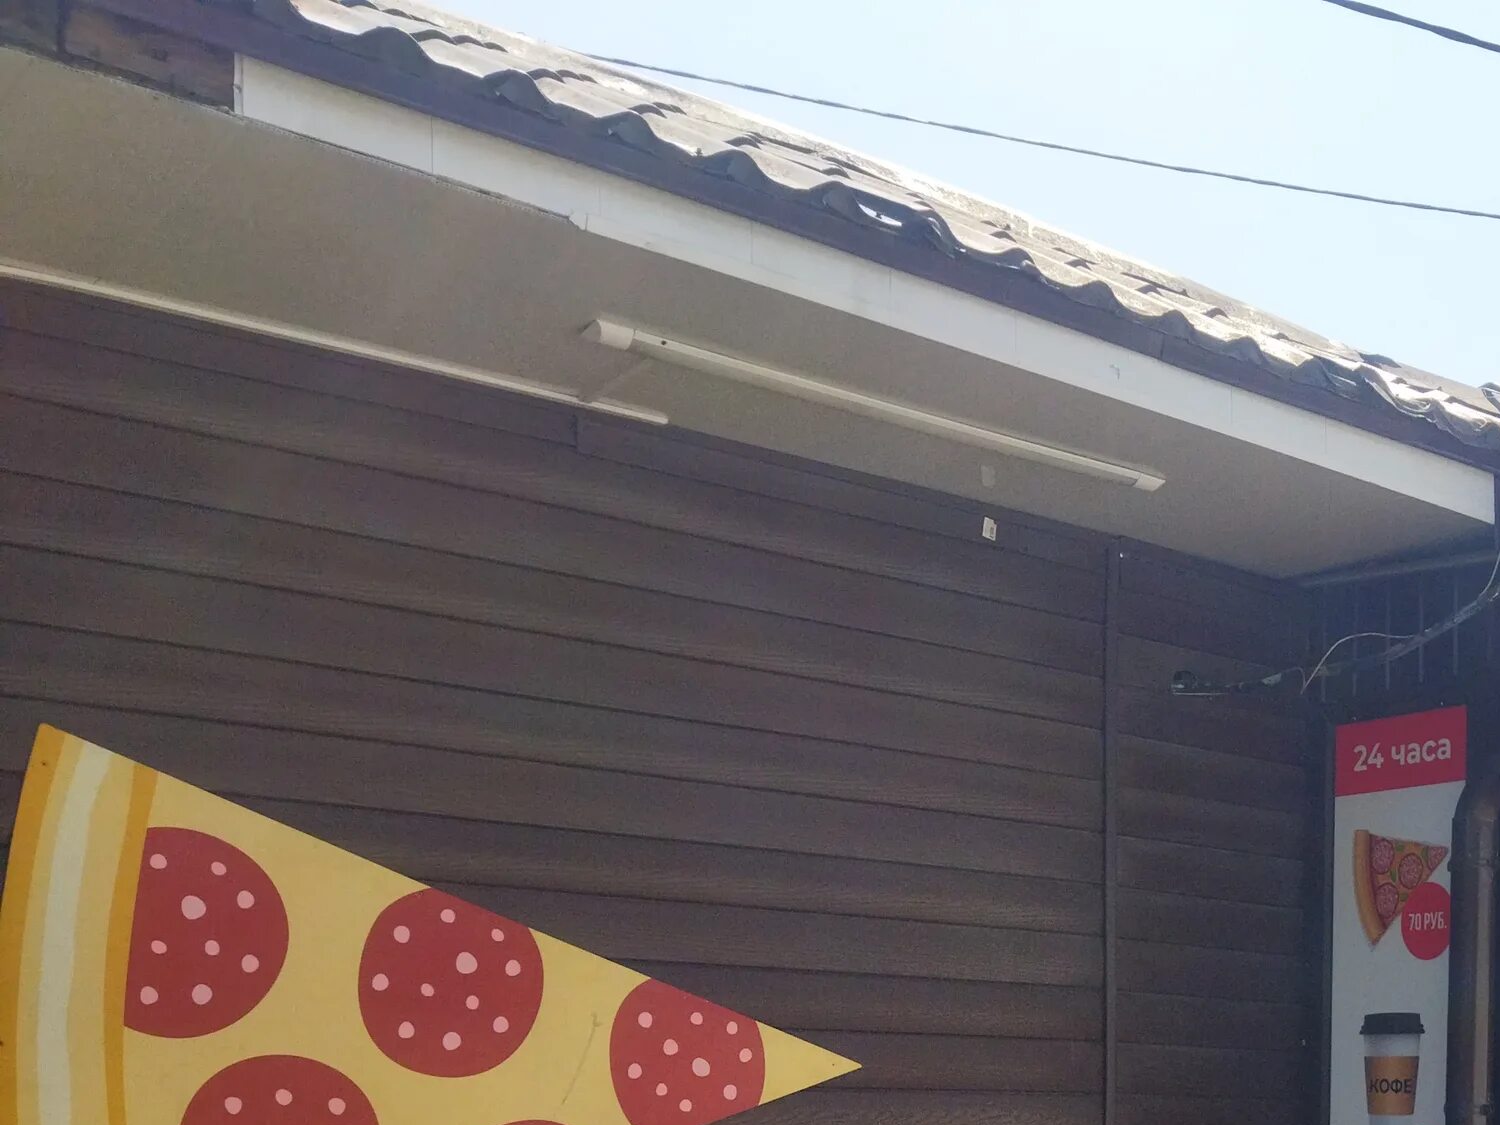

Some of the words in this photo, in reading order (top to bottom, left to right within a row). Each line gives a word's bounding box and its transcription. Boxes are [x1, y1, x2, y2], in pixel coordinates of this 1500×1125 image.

[1353, 743, 1384, 772] 24
[1390, 738, 1451, 766] часа
[1408, 912, 1422, 931] 70
[1423, 911, 1448, 931] РУБ.
[1369, 1078, 1413, 1095] КОФЕ
